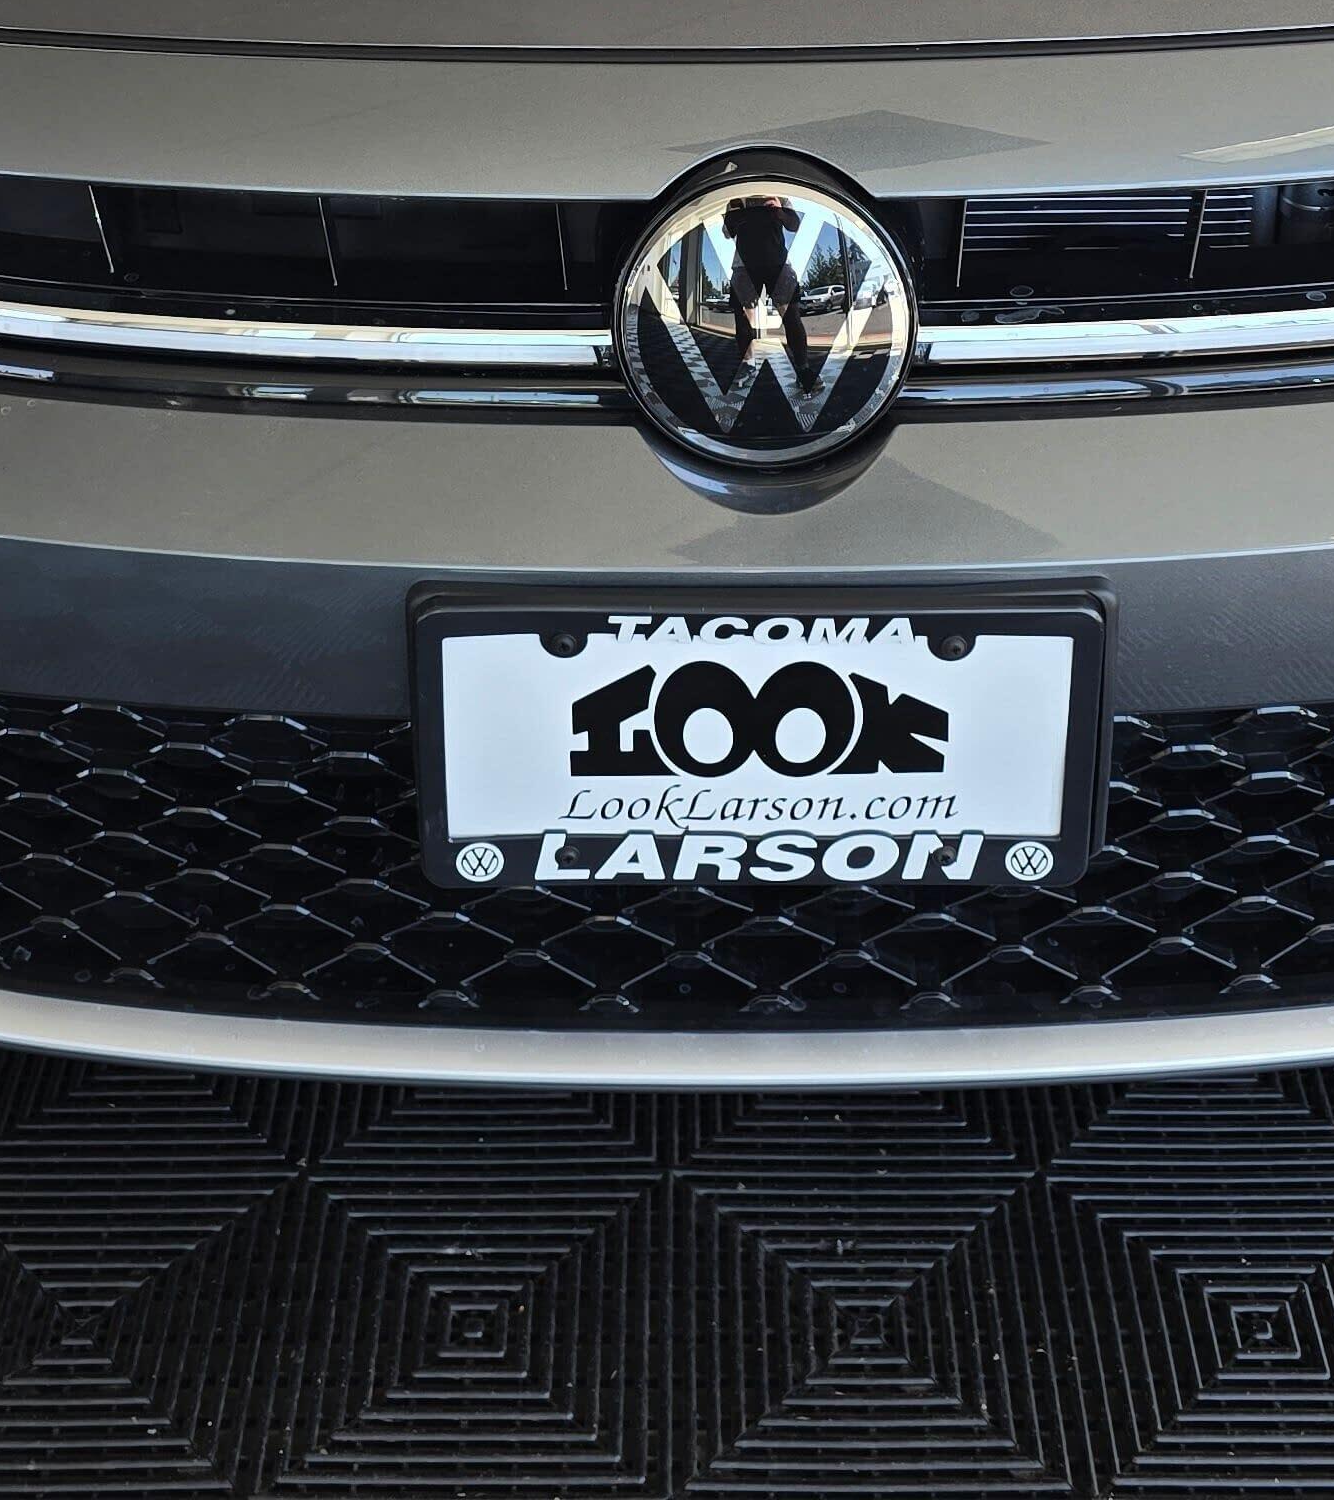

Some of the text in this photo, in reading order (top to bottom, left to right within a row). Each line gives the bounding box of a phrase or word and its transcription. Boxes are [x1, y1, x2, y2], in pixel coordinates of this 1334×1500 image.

[607, 615, 918, 644] TACOMA
[569, 660, 949, 778] LOOK
[559, 784, 959, 830] LookLarson.com
[534, 832, 985, 881] LARSON
